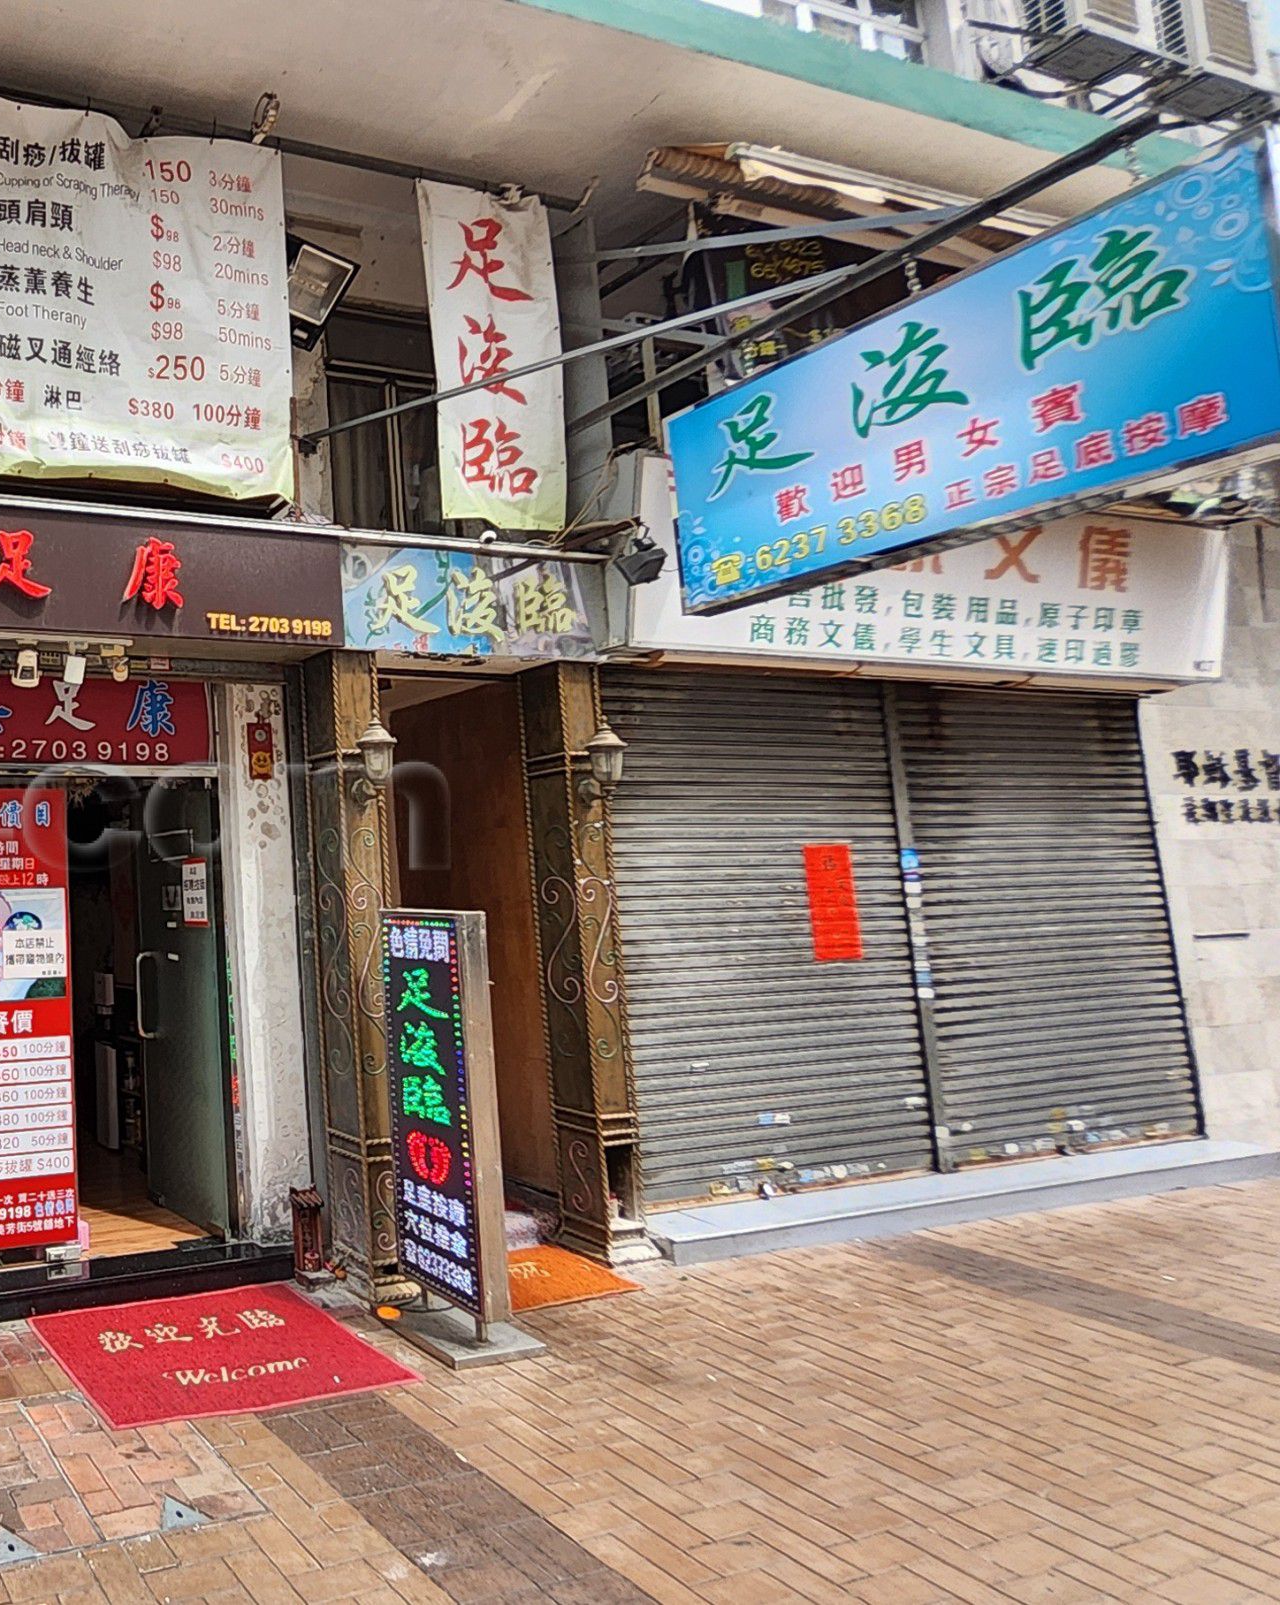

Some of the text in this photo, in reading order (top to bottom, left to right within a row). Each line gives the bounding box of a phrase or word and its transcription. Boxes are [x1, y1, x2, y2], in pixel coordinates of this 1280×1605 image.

[43, 176, 53, 187] or
[209, 197, 265, 221] 30mins
[32, 244, 60, 259] neck
[63, 246, 72, 260] &
[75, 247, 124, 270] Shoulder
[153, 250, 182, 272] $98
[215, 263, 269, 286] 20mins
[151, 321, 183, 341] $98
[219, 327, 271, 351] 50mins
[44, 385, 82, 411] 淋巴
[128, 399, 174, 420] $380
[193, 403, 261, 430] 100分鐘
[221, 454, 264, 473] $400
[776, 384, 1081, 522] 歡迎男女賓
[944, 392, 1228, 510] 正宗足底按摩
[837, 493, 927, 545] 3368
[207, 613, 332, 636] TEL: 2703 9198
[11, 739, 87, 759] 2703
[97, 742, 170, 762] 9198
[37, 1156, 70, 1171] $400
[0, 1205, 31, 1220] 9198
[163, 1356, 309, 1386] Welcome
